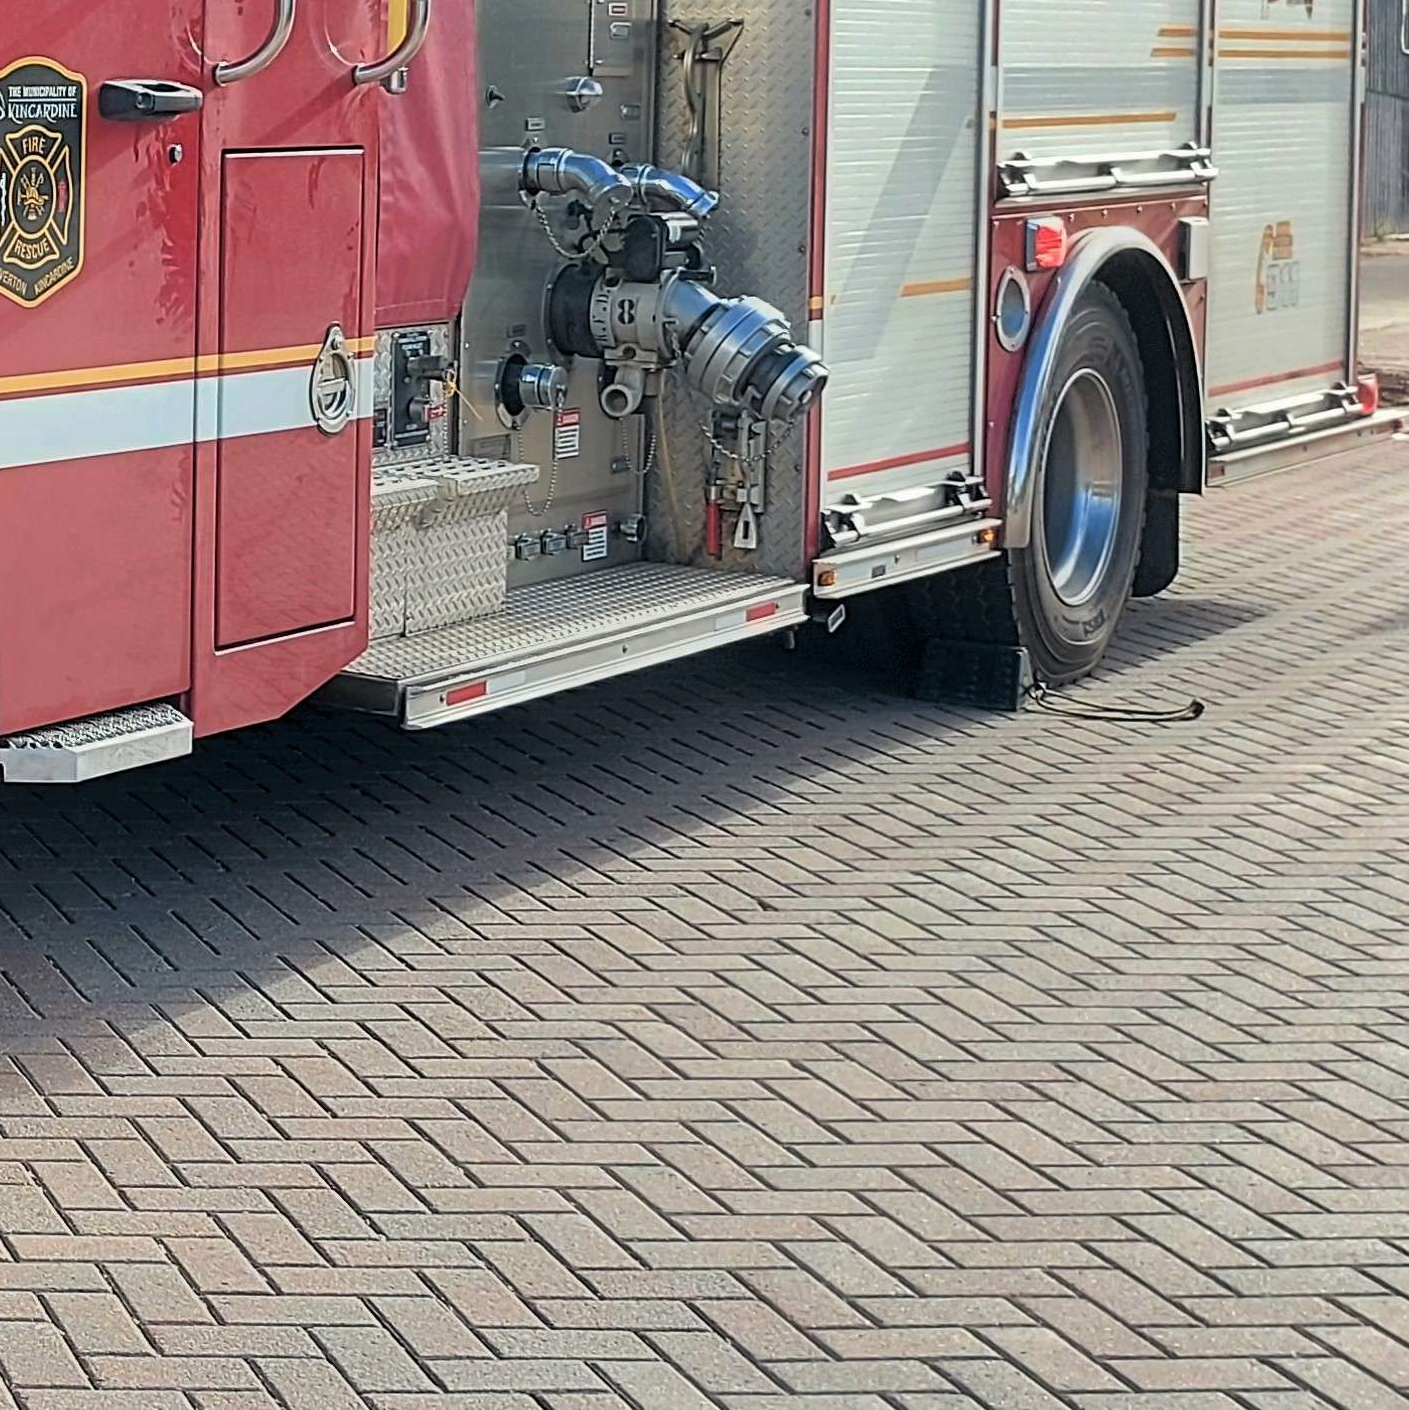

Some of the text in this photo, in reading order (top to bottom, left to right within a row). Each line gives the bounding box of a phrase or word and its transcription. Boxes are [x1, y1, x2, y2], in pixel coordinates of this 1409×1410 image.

[8, 86, 22, 97] THE
[8, 103, 77, 124] KINCARDINE
[22, 136, 45, 155] FIRE
[14, 238, 50, 260] RESCUE
[34, 256, 75, 295] KINCARDINE
